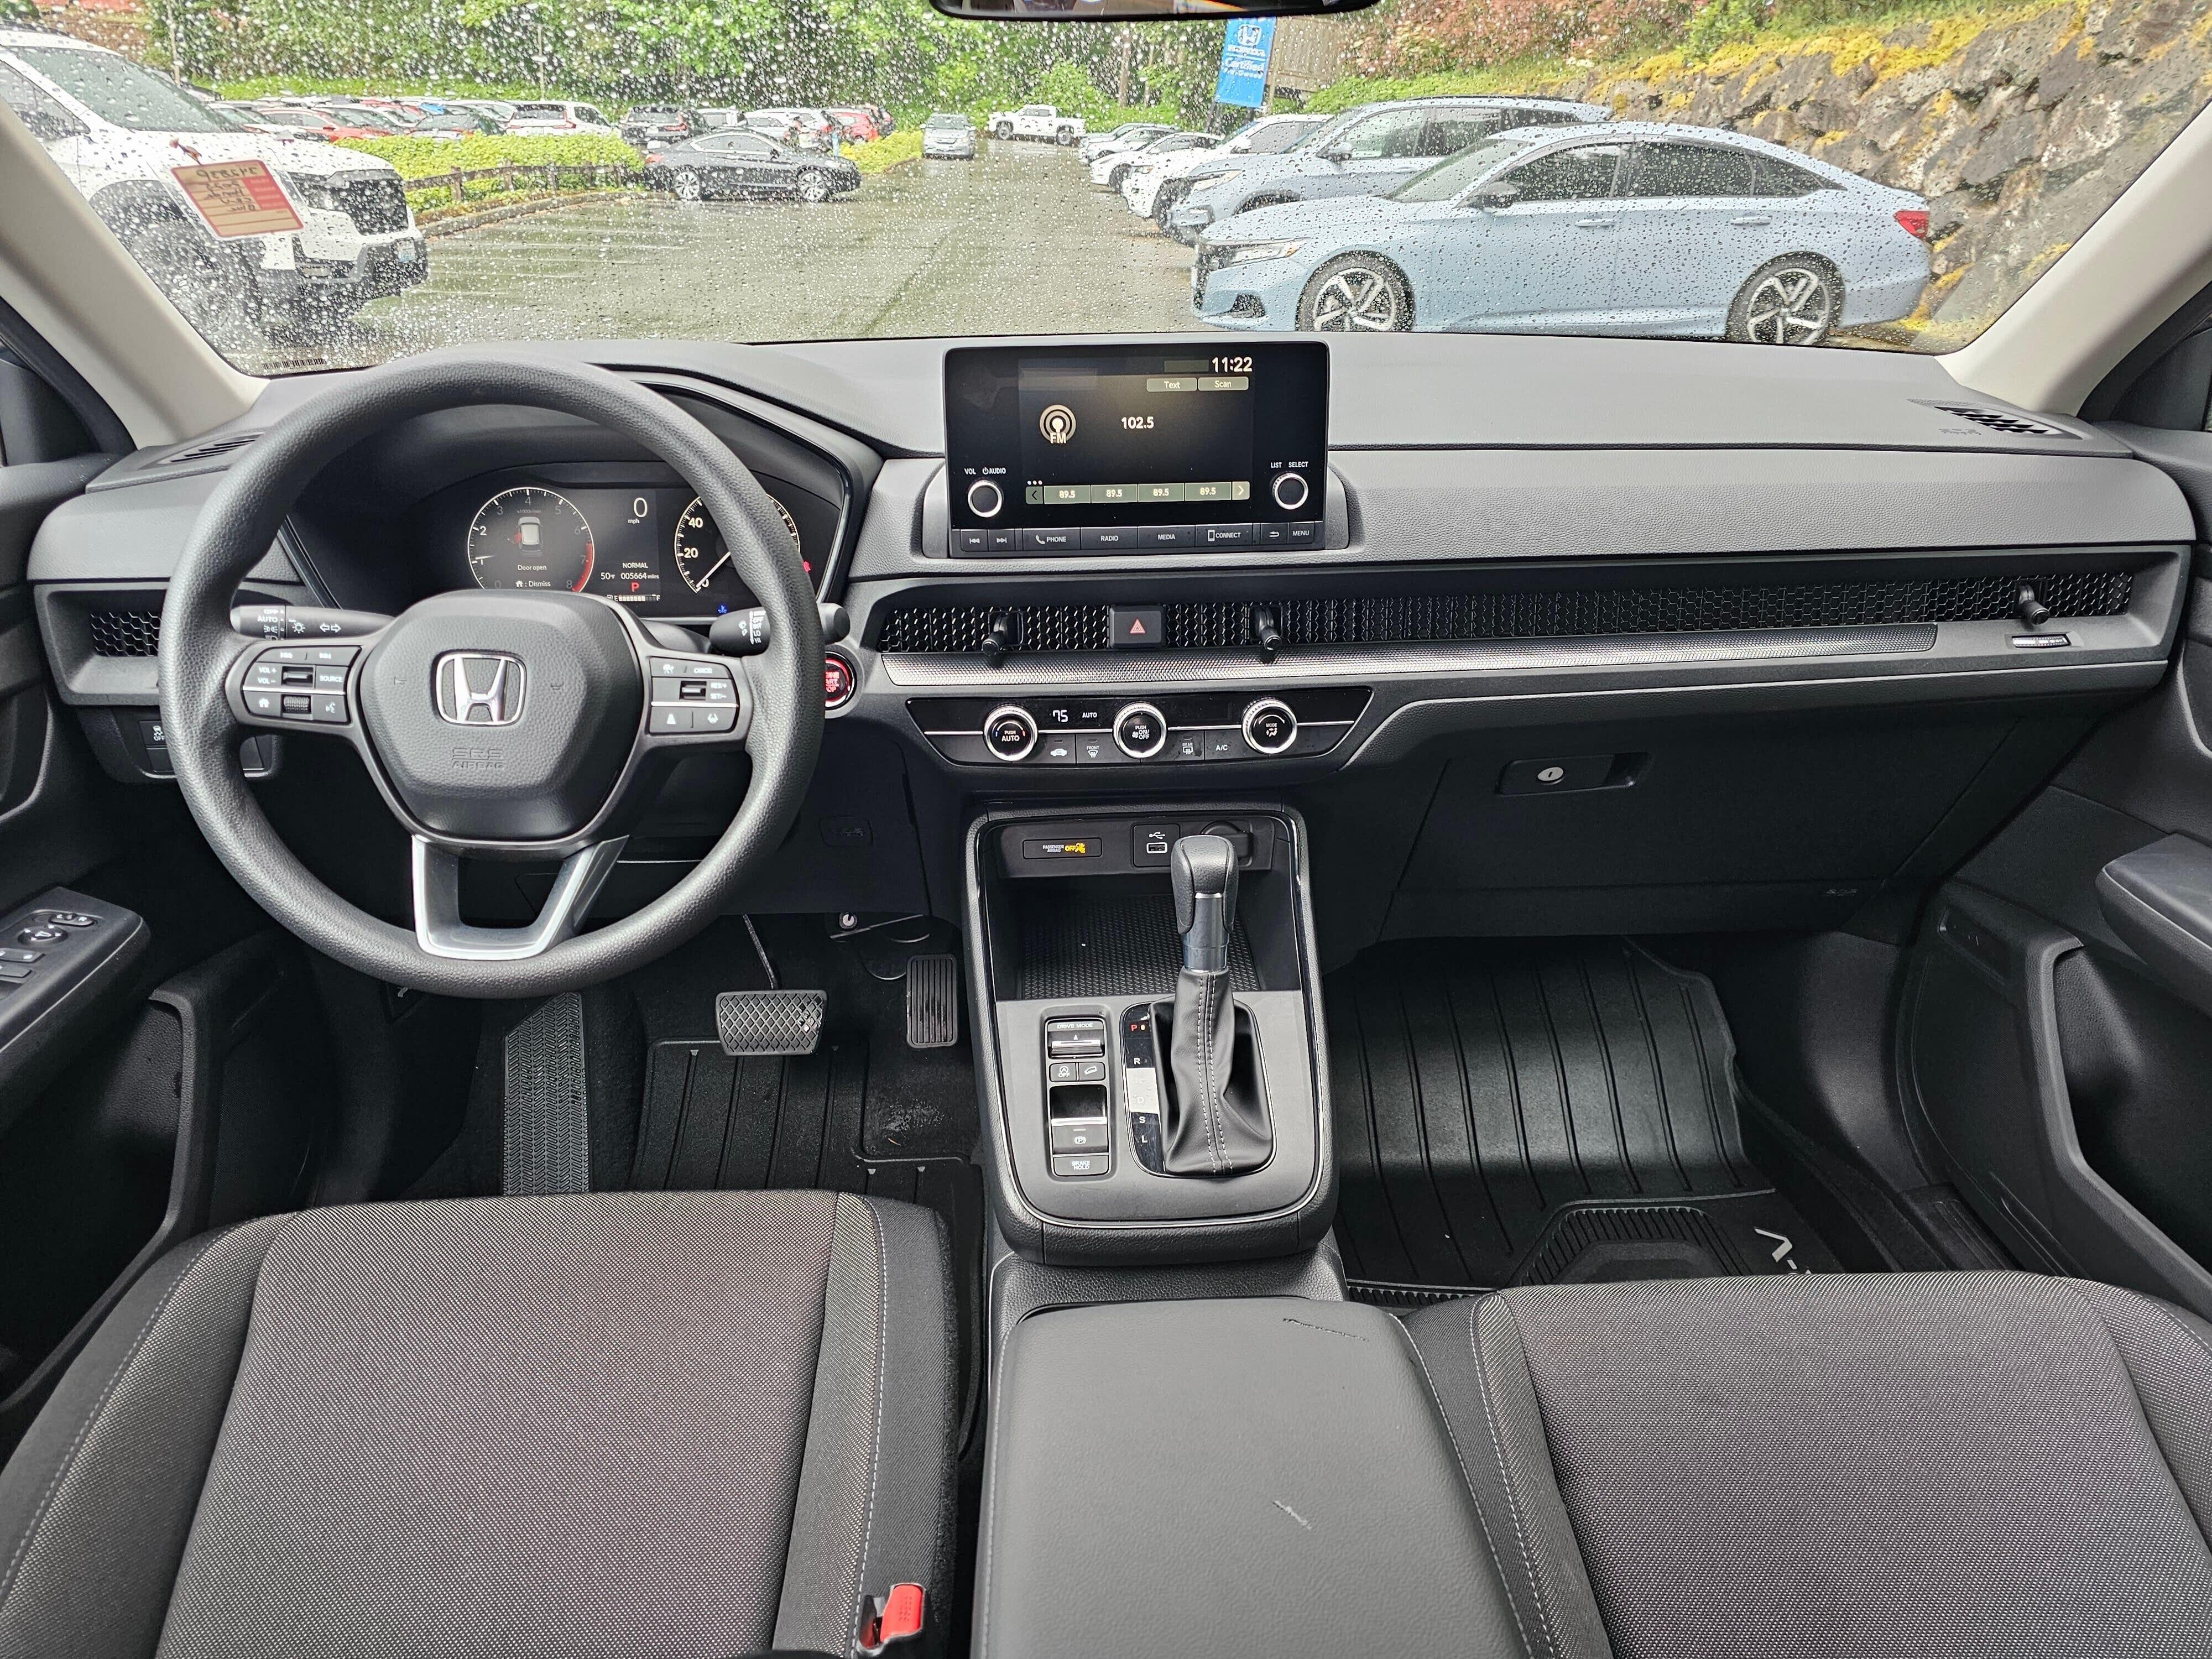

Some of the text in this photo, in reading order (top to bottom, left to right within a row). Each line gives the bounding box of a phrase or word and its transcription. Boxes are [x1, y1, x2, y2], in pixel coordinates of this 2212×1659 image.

[1212, 356, 1253, 373] 11:22
[1164, 380, 1181, 390] Text
[1214, 380, 1232, 388] Scan
[1121, 416, 1155, 430] 102.5
[1050, 432, 1067, 444] FM
[1058, 490, 1076, 498] 89.5
[1105, 489, 1123, 498] 89.5
[1152, 488, 1170, 497] 89.5
[1199, 487, 1217, 495] 89.5
[524, 497, 531, 505] 4
[497, 505, 504, 515] 3
[555, 506, 561, 515] 5
[633, 497, 648, 518] 0
[688, 517, 703, 528] 40
[479, 525, 487, 536] 2
[574, 526, 581, 535] 6
[684, 547, 698, 559] 20
[580, 555, 586, 565] 7
[566, 580, 573, 589] 8
[631, 582, 640, 593] P
[1052, 709, 1068, 723] 75
[452, 748, 504, 760] SRS
